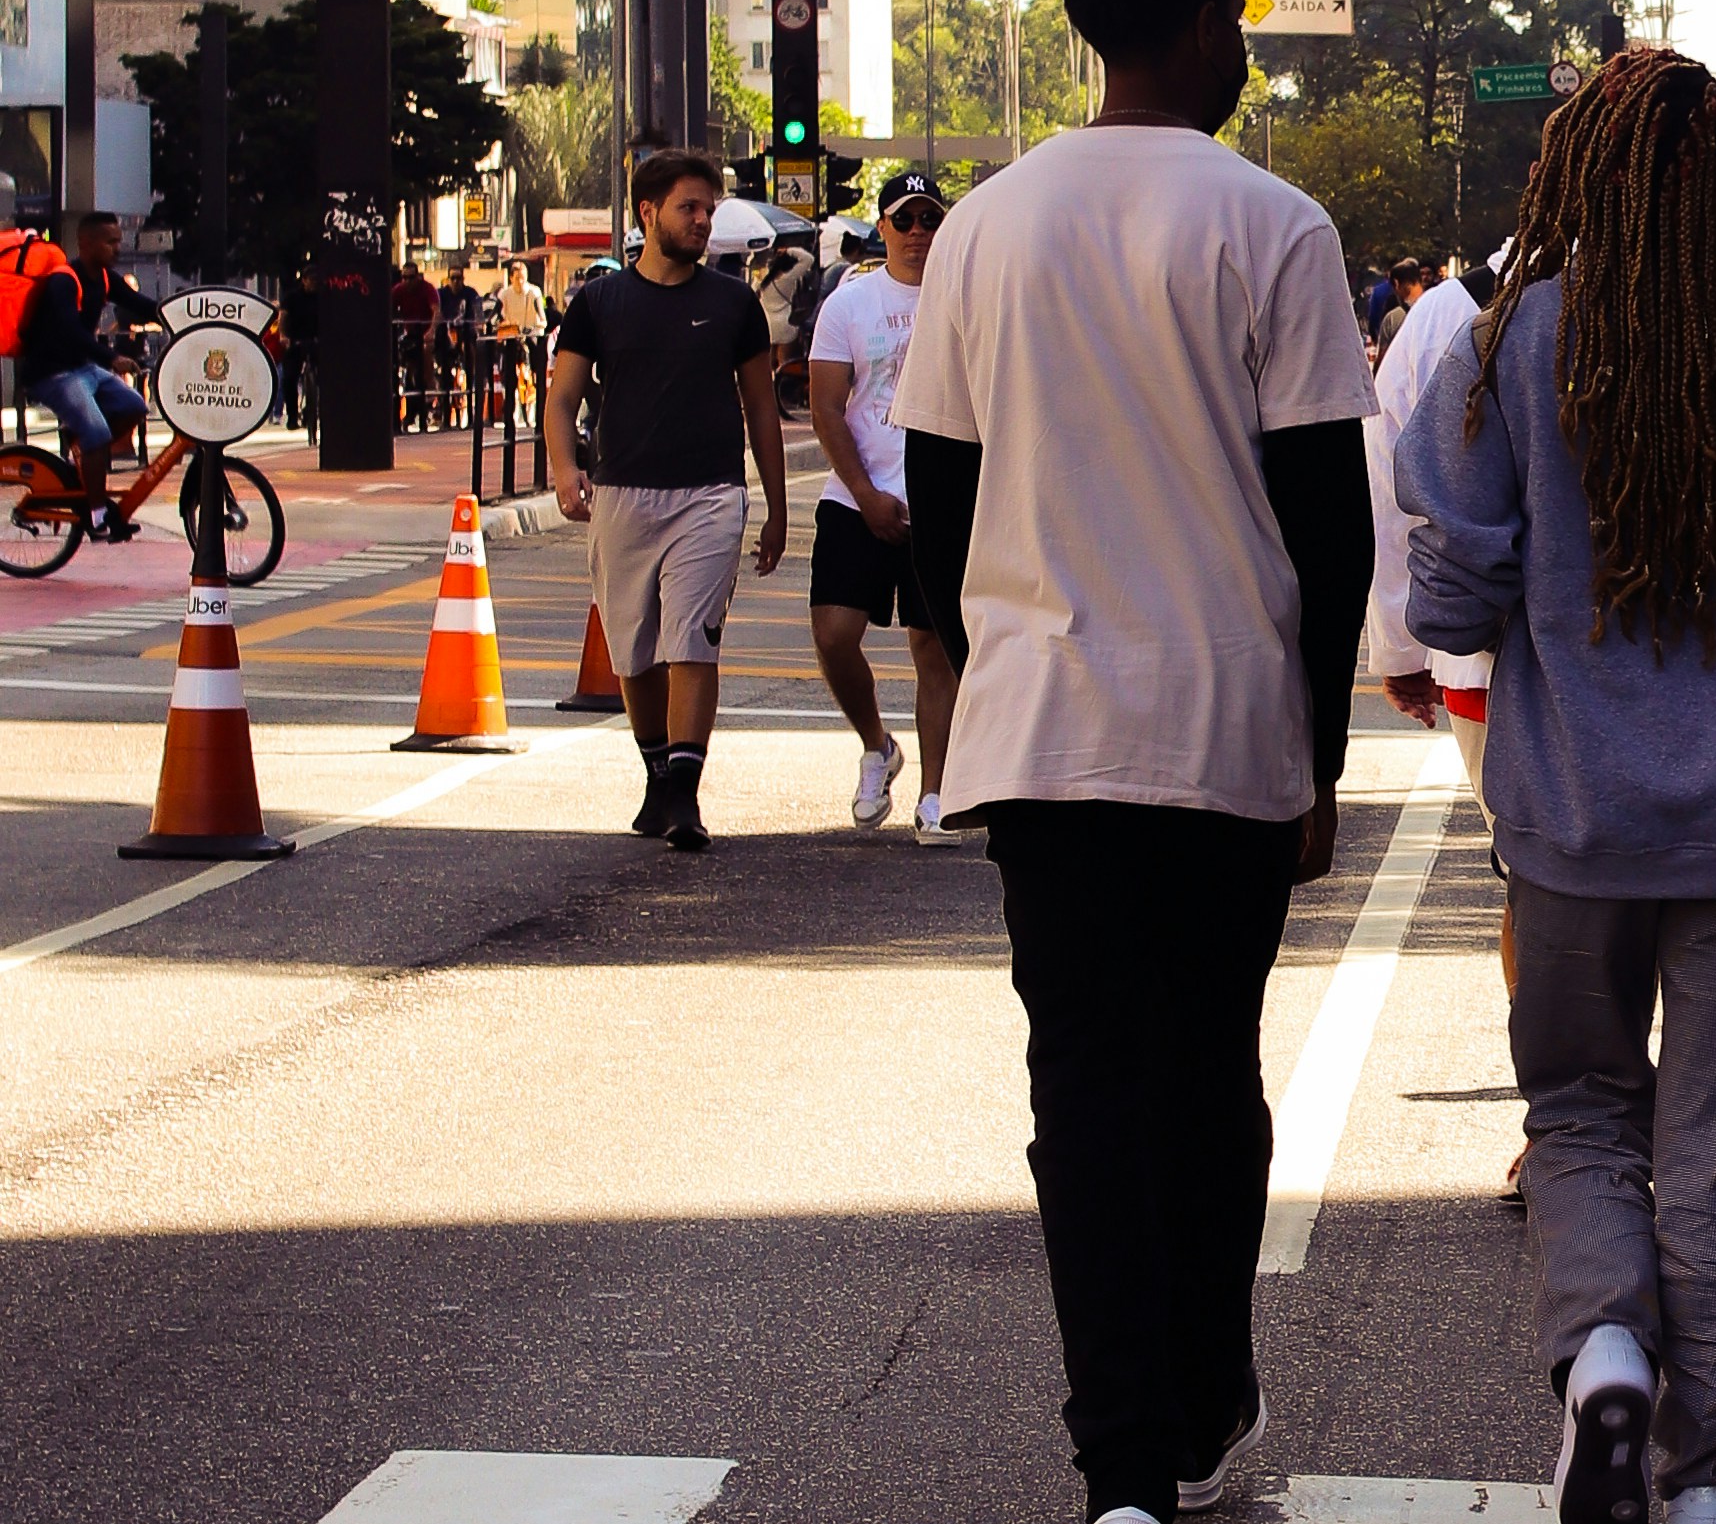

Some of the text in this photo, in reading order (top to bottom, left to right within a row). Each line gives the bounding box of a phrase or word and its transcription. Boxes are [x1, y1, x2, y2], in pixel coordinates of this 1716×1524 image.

[185, 296, 247, 320] Uber
[185, 382, 244, 396] CIDADE DE
[207, 396, 252, 409] PAULO
[188, 596, 227, 615] Uber
